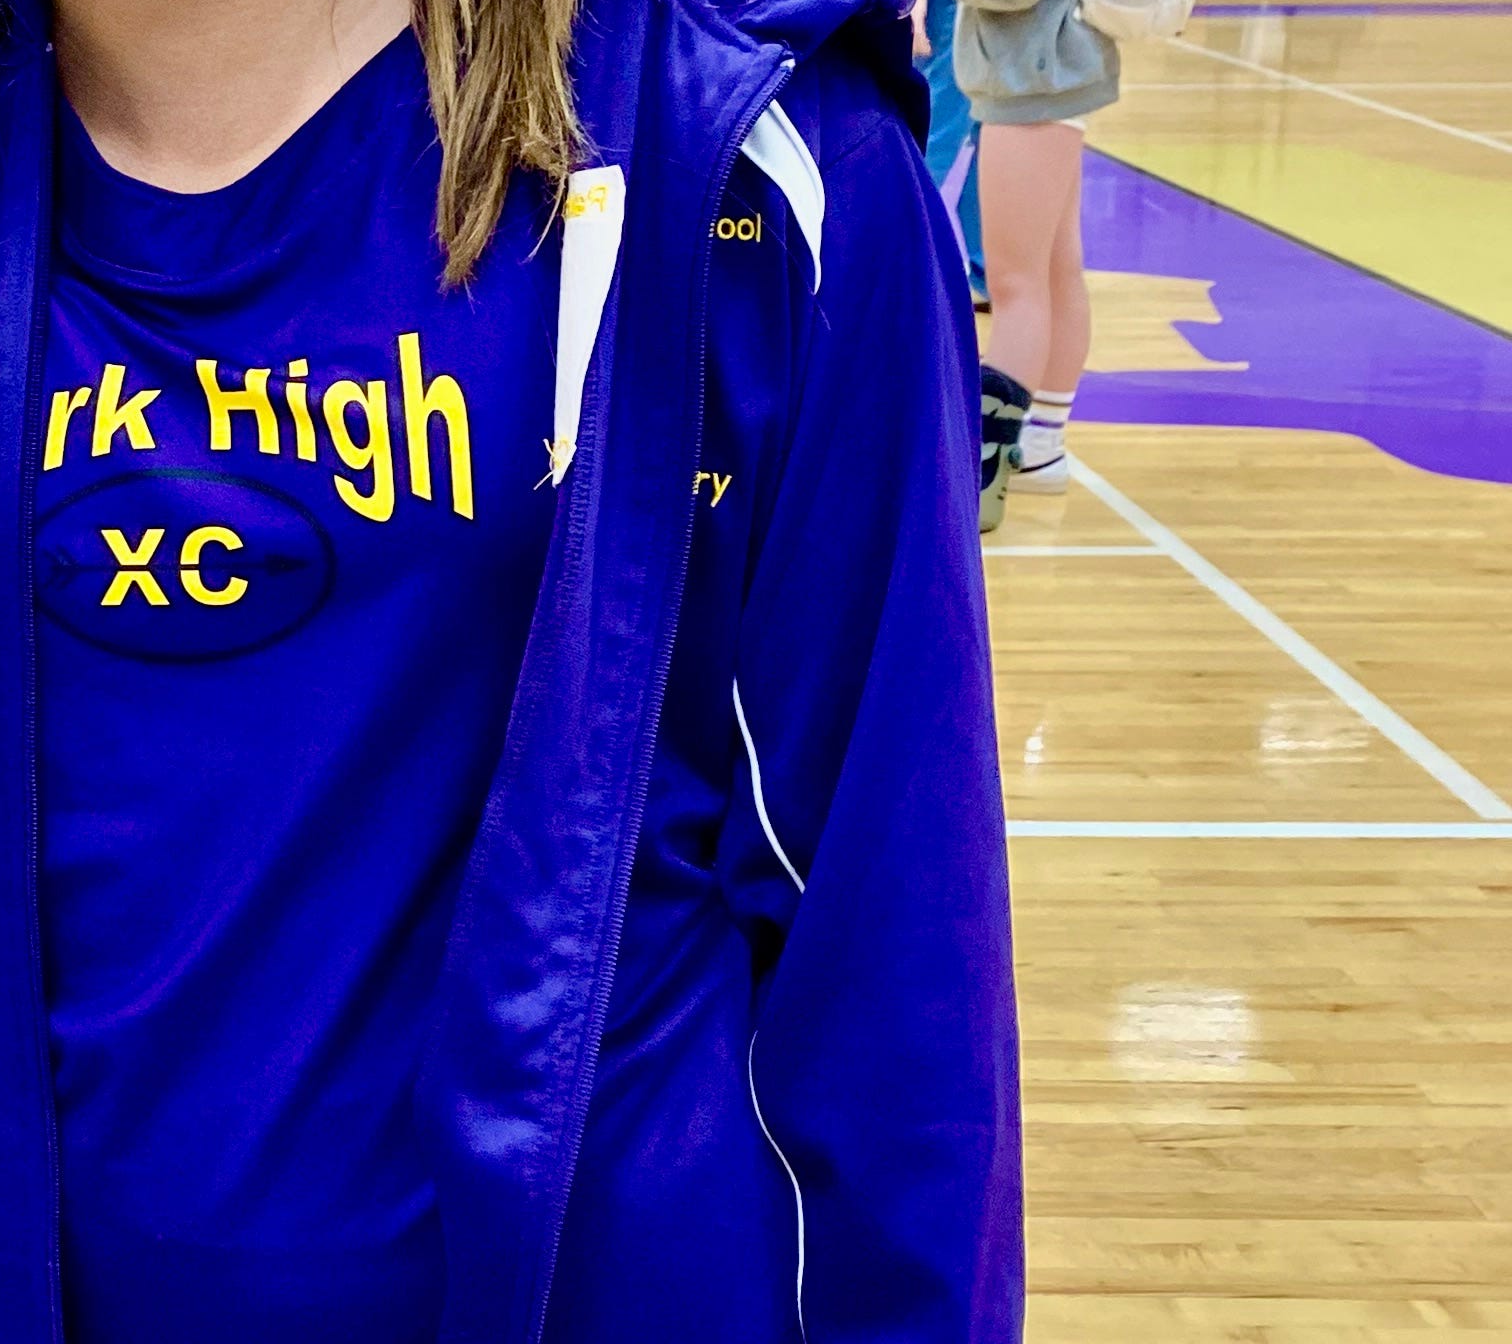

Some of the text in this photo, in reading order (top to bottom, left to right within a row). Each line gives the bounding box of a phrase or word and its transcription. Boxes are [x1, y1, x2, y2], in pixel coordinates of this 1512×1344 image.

[713, 213, 761, 243] ool
[43, 332, 474, 522] rk High
[100, 526, 248, 606] XC
